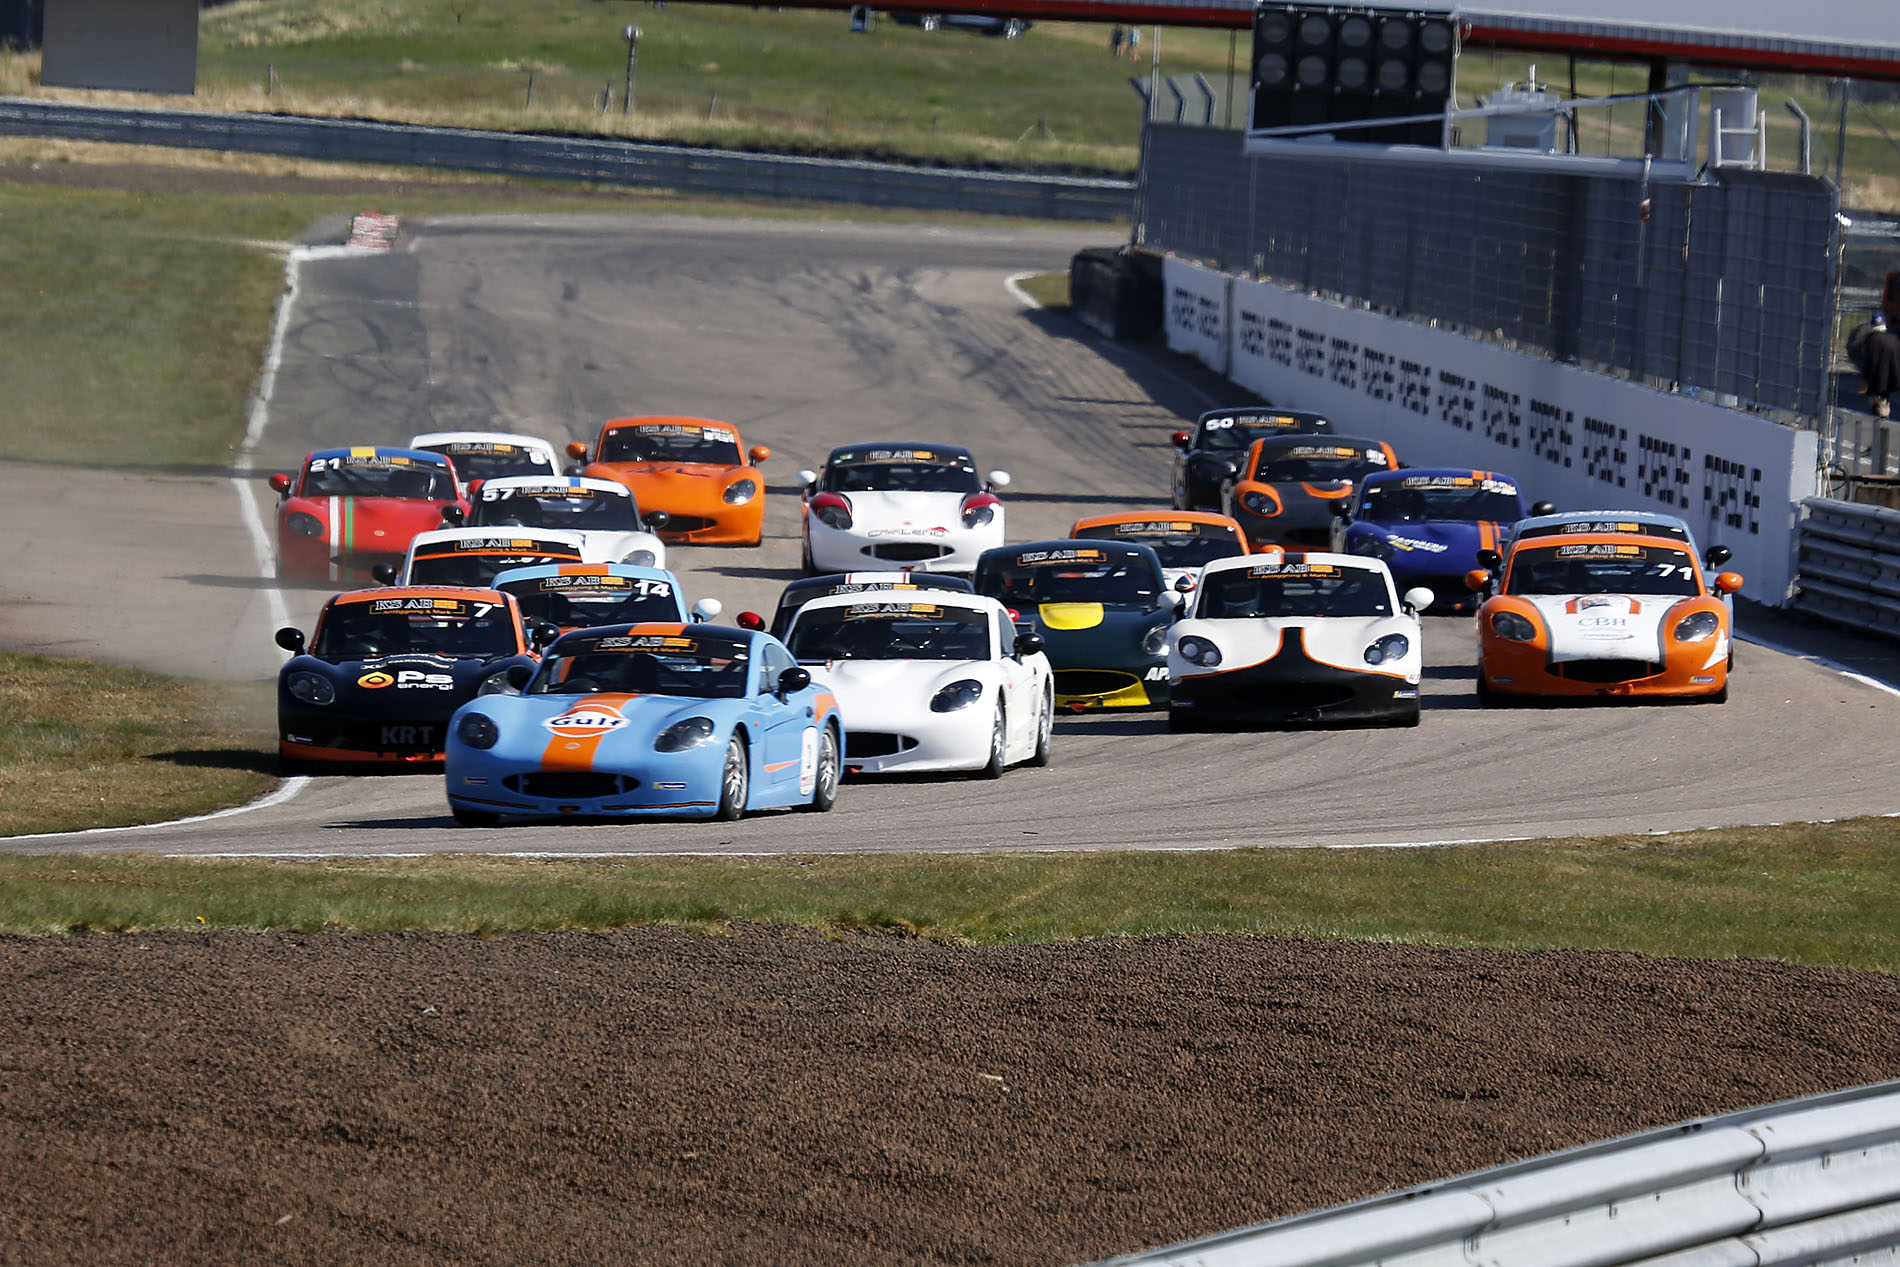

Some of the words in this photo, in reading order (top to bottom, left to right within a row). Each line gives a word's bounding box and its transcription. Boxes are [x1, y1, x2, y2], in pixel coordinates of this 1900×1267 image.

[311, 457, 340, 473] 21
[482, 487, 516, 502] 57
[1657, 563, 1693, 580] 71
[634, 580, 670, 598] 14
[473, 602, 493, 618] 7
[1578, 617, 1627, 626] CBH
[397, 670, 454, 684] Ps
[1144, 667, 1170, 681] AP
[397, 683, 454, 691] energi
[551, 717, 623, 726] Gulf
[381, 725, 435, 745] KRT
